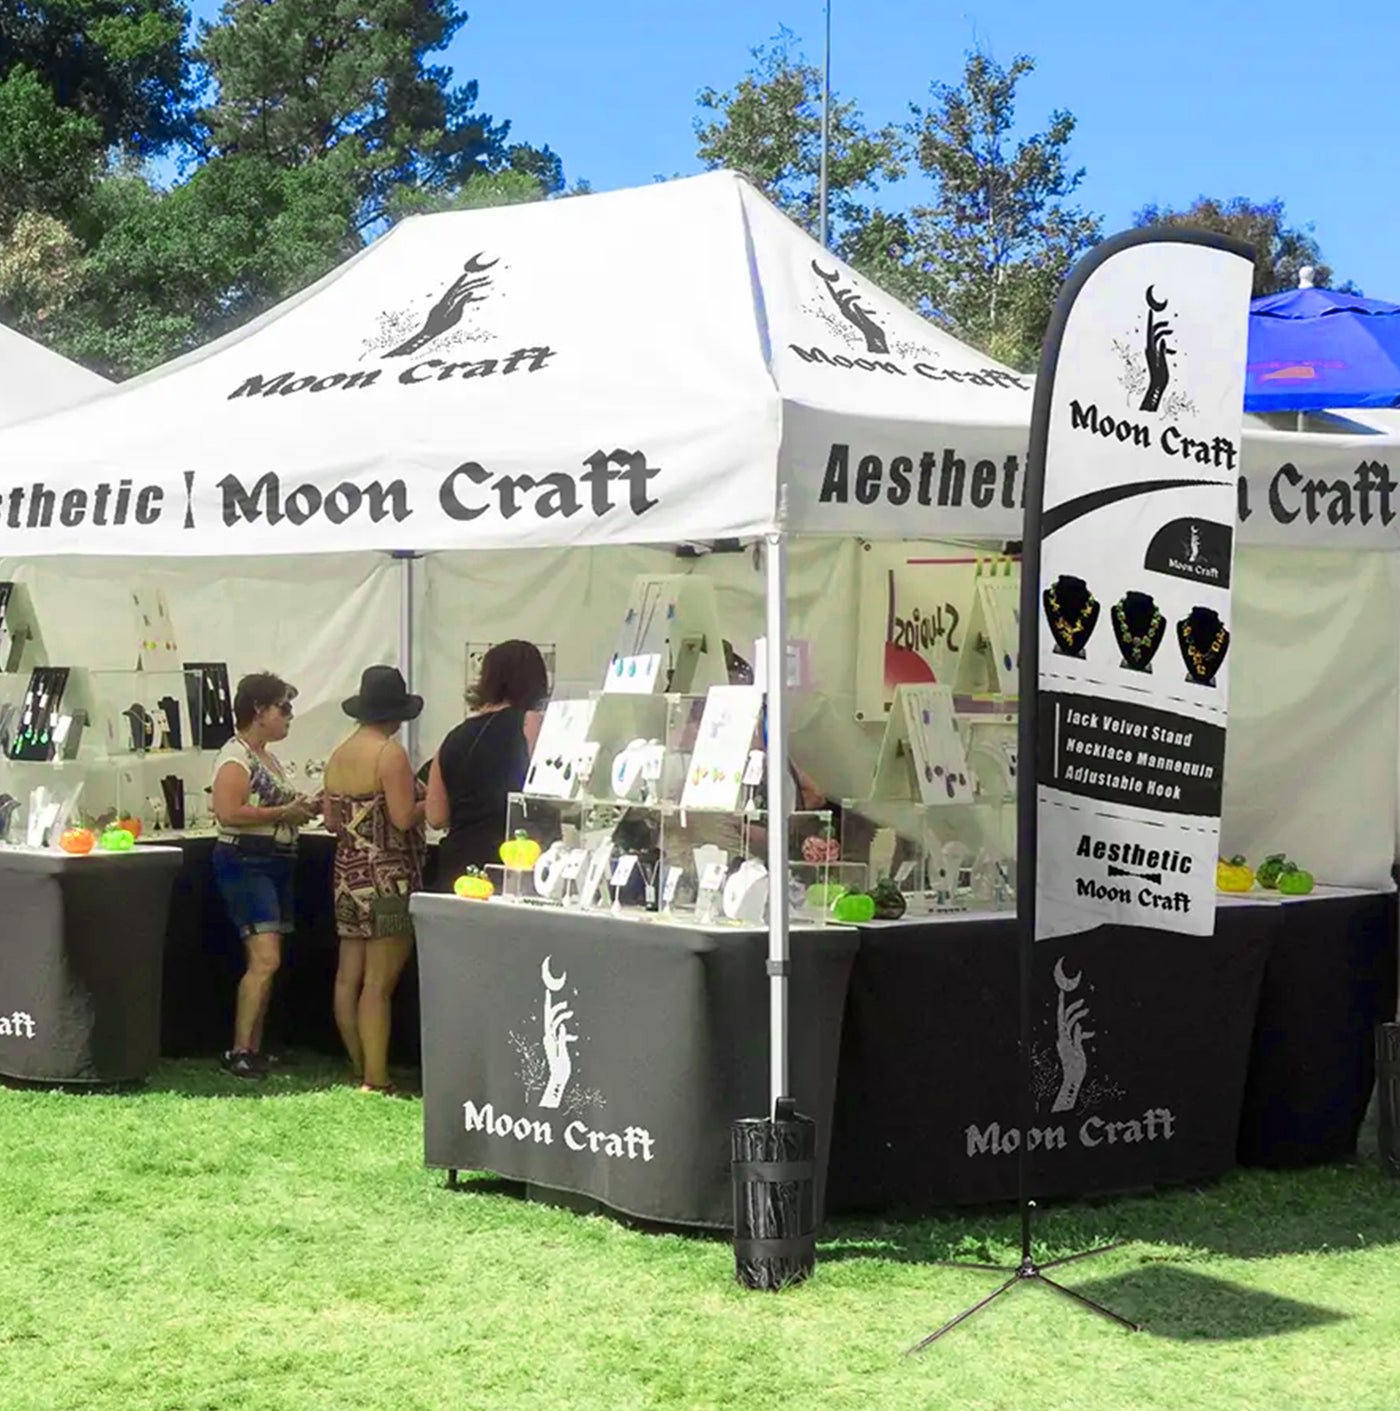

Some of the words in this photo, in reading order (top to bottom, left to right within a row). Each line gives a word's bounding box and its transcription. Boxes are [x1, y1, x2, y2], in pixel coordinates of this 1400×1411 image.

[227, 368, 383, 401] Moon
[397, 345, 558, 386] Craft
[788, 343, 907, 376] Moon
[913, 362, 1030, 392] Craft
[1069, 399, 1151, 448] Moon
[1160, 425, 1237, 471] Craft
[215, 470, 413, 528] Moon
[438, 447, 661, 523] Craft
[818, 442, 1029, 510] Aesthet
[1268, 459, 1399, 527] Craft
[1168, 557, 1193, 573] Moon
[1194, 564, 1219, 579] Craft
[1102, 715, 1149, 739] Velvet
[1150, 725, 1194, 748] Stand
[1064, 764, 1144, 793] Adjustable
[1146, 780, 1182, 800] Hook
[1065, 737, 1133, 764] Necklace
[1135, 750, 1215, 780] Mannequin
[1076, 834, 1192, 875] Aesthetic
[1075, 877, 1132, 904] Moon
[1138, 888, 1191, 913] Craft
[462, 1099, 554, 1146] Moon
[564, 1120, 656, 1162] Craft
[964, 1121, 1068, 1158] Moon
[1079, 1107, 1177, 1148] Craft
